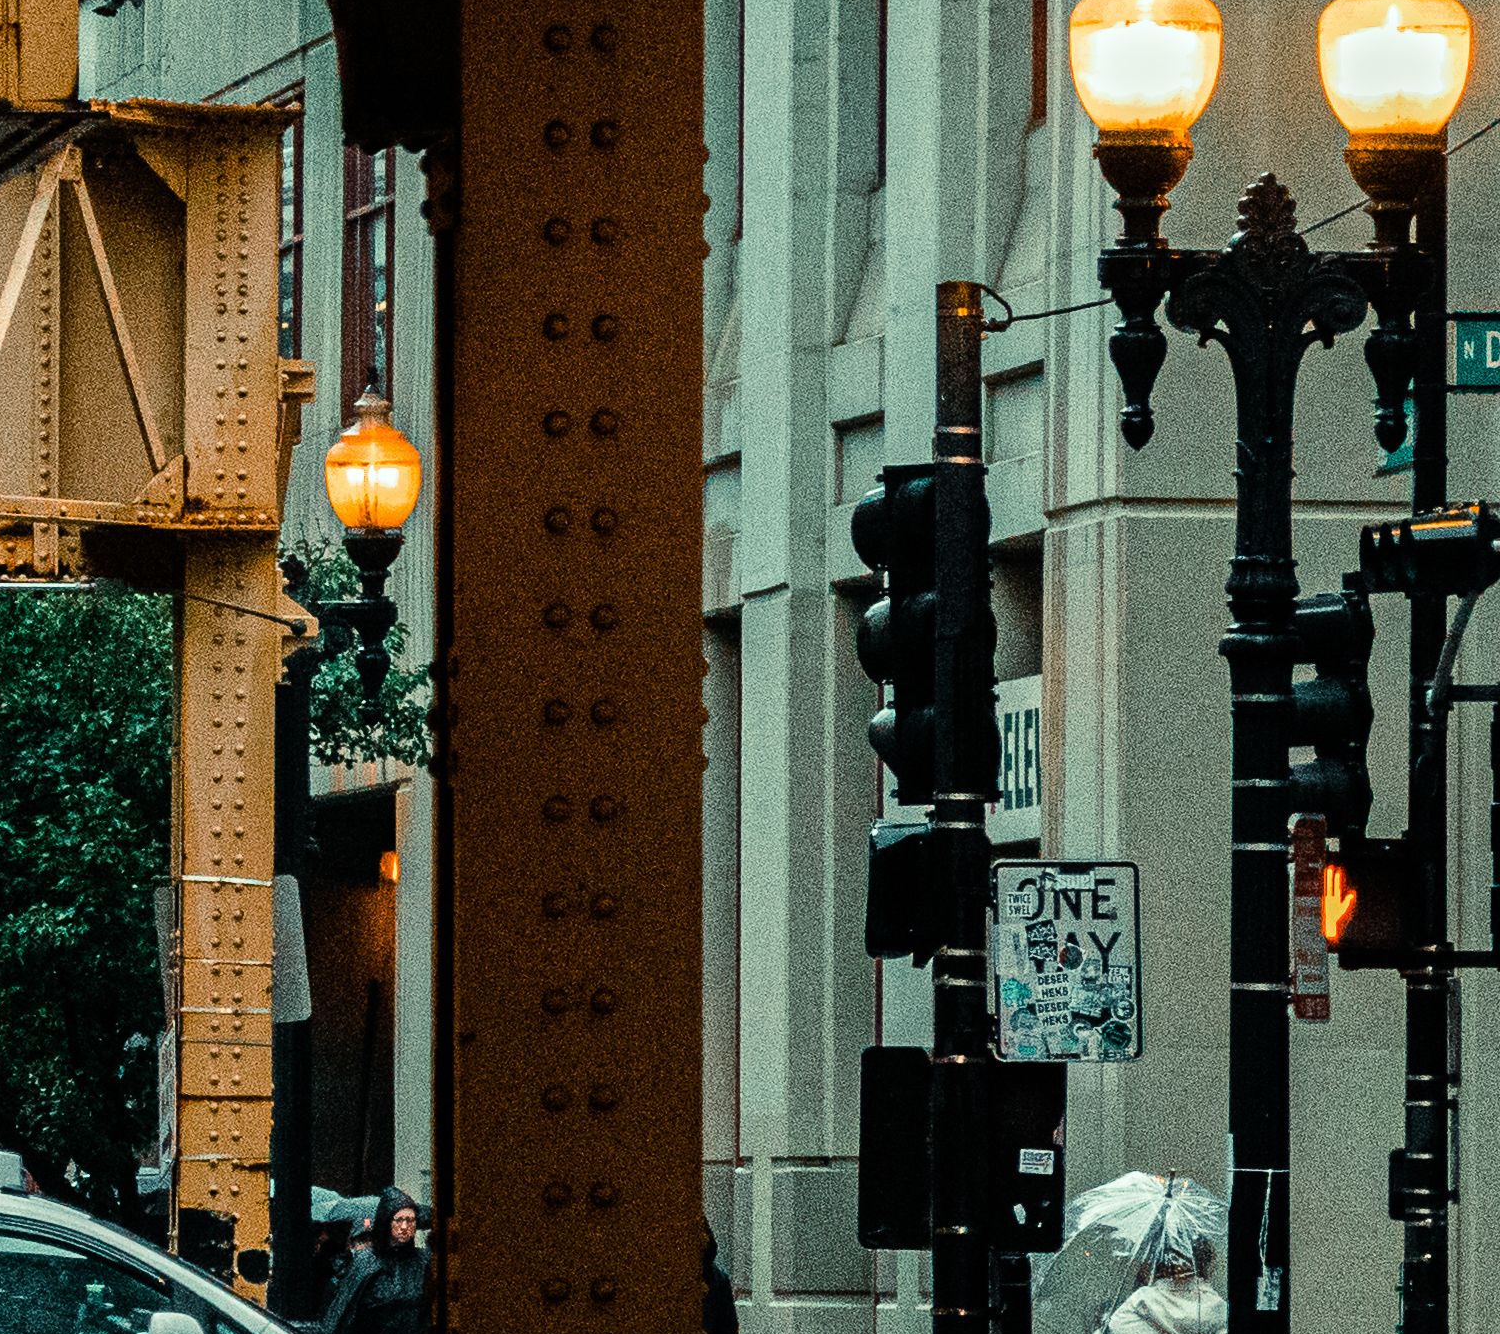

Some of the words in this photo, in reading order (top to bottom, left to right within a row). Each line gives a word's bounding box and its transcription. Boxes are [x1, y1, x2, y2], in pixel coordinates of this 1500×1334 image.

[1463, 340, 1475, 360] N
[1008, 893, 1032, 904] TWICE
[1017, 877, 1118, 921] ONE
[1037, 973, 1069, 986] DESER
[1037, 1001, 1069, 1013] DESER
